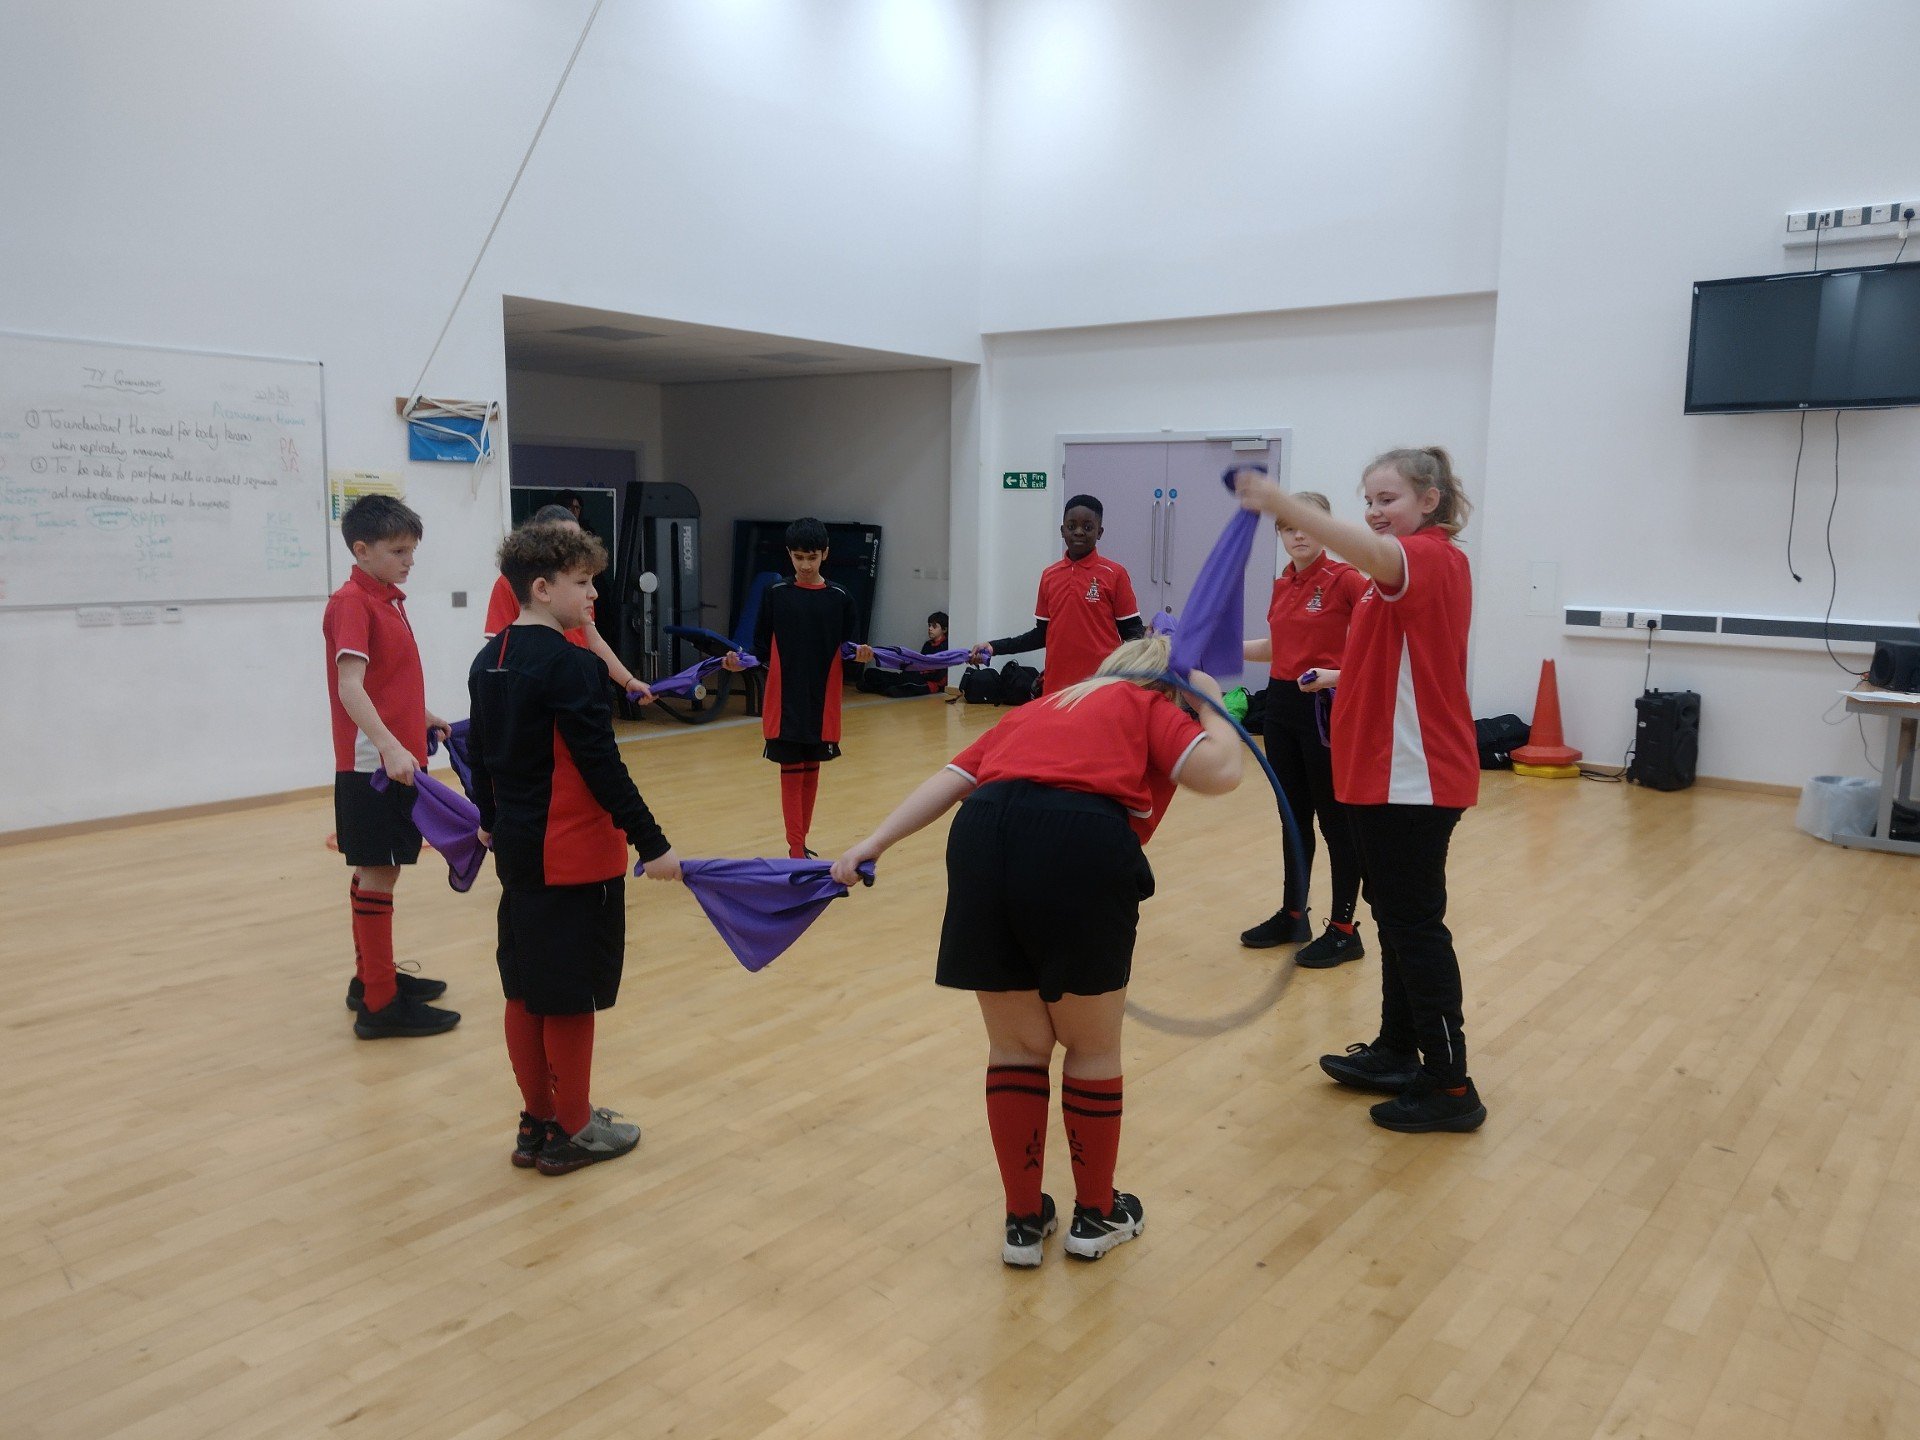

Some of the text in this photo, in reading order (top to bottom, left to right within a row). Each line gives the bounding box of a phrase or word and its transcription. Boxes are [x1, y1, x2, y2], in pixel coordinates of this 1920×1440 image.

[129, 413, 146, 435] the
[151, 424, 174, 437] need
[178, 420, 191, 442] for
[195, 421, 218, 452] body
[51, 438, 76, 452] when
[50, 456, 73, 474] To
[1031, 473, 1044, 481] Fire
[51, 486, 69, 501] and
[683, 525, 693, 571] PRECOR
